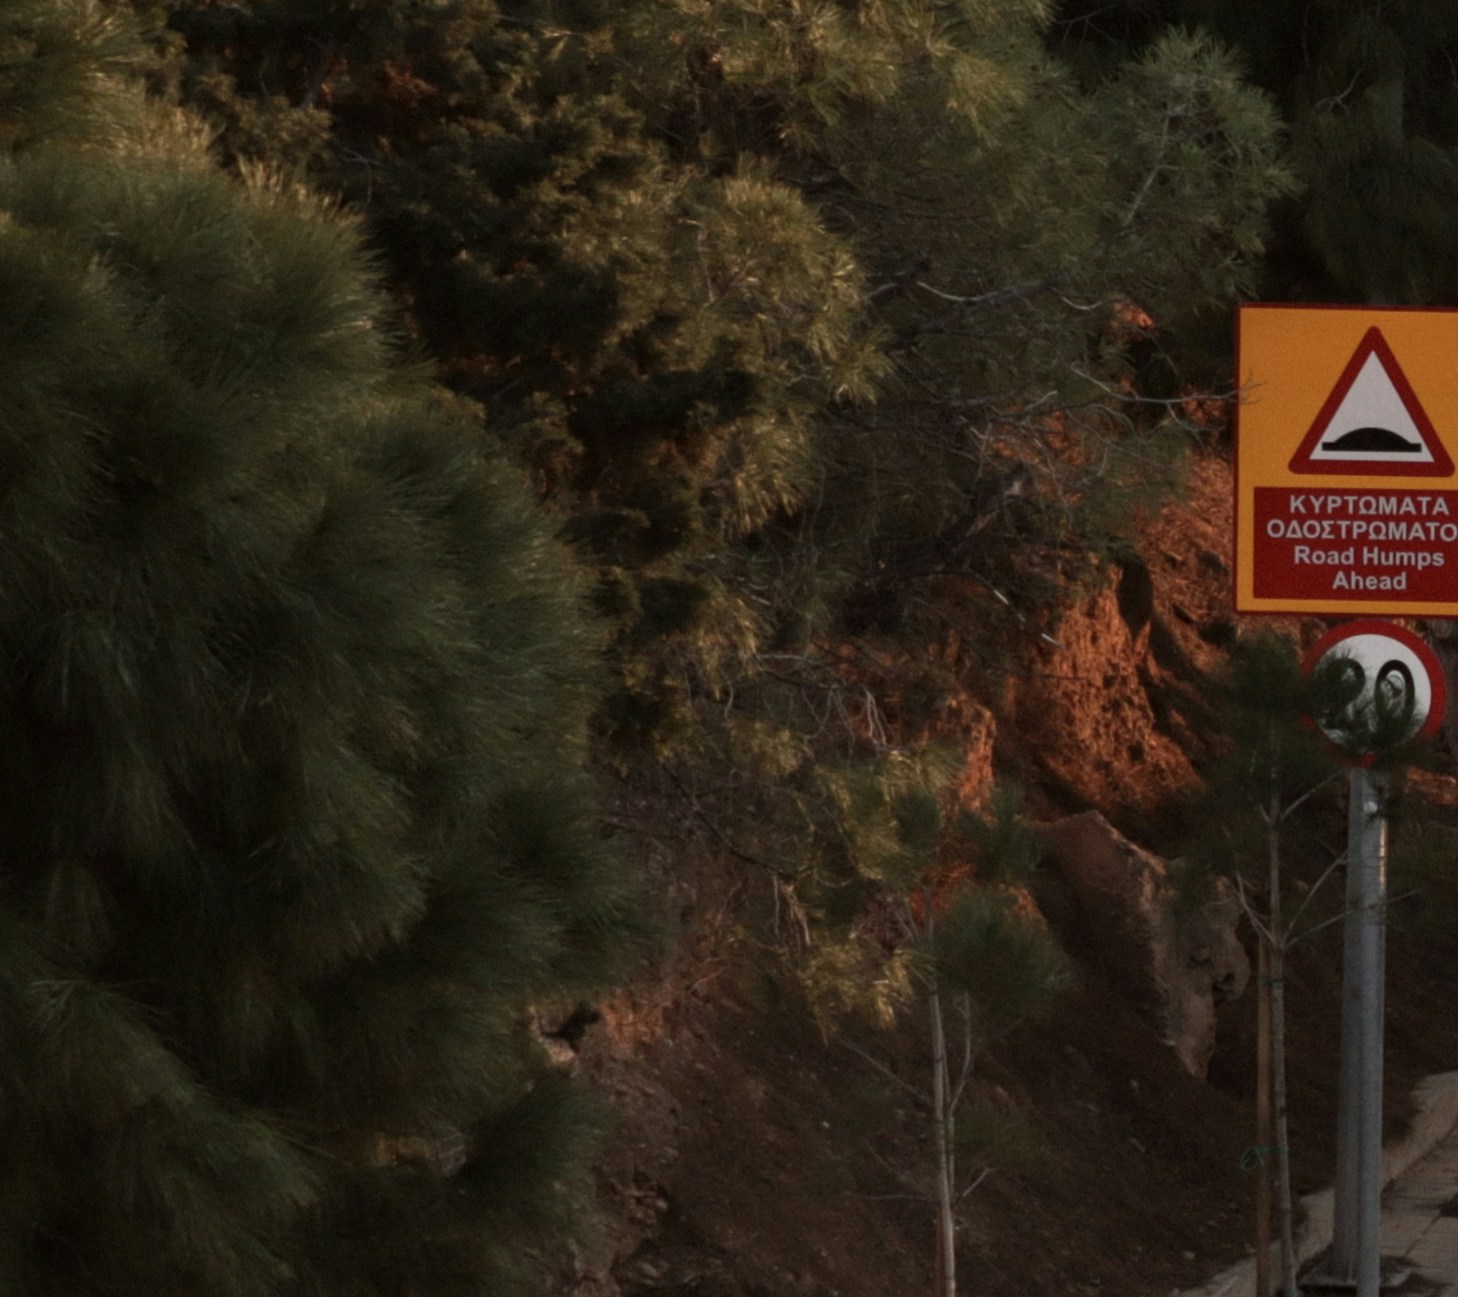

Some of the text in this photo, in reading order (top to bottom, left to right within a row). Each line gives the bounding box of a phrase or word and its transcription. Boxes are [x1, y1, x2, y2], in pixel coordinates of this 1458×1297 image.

[1289, 494, 1450, 516] ΚΥΡΤΩΜΑΤΑ
[1294, 545, 1445, 570] Road Humps
[1332, 570, 1408, 590] Ahead
